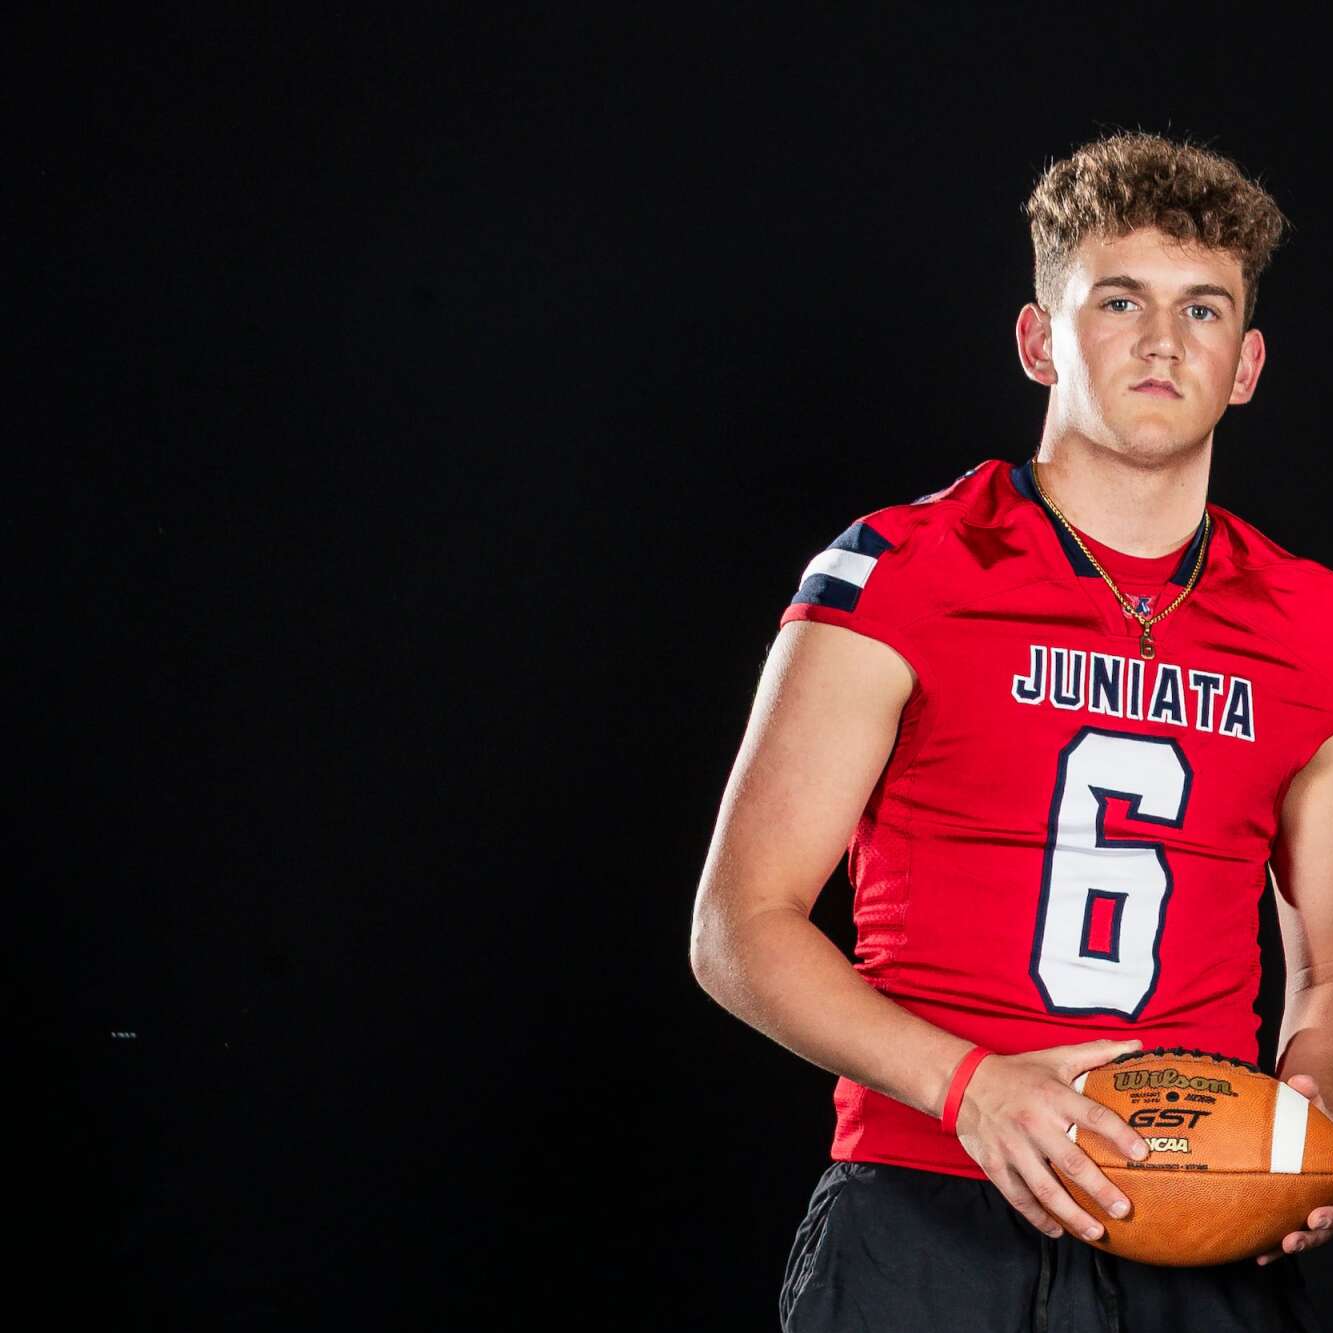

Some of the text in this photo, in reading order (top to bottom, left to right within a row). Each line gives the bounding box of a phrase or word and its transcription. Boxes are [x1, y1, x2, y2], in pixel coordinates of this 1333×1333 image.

[1011, 645, 1256, 742] JUNIATA
[1029, 725, 1194, 1022] 6
[1113, 1068, 1233, 1094] Wilson
[1129, 1108, 1212, 1129] GST
